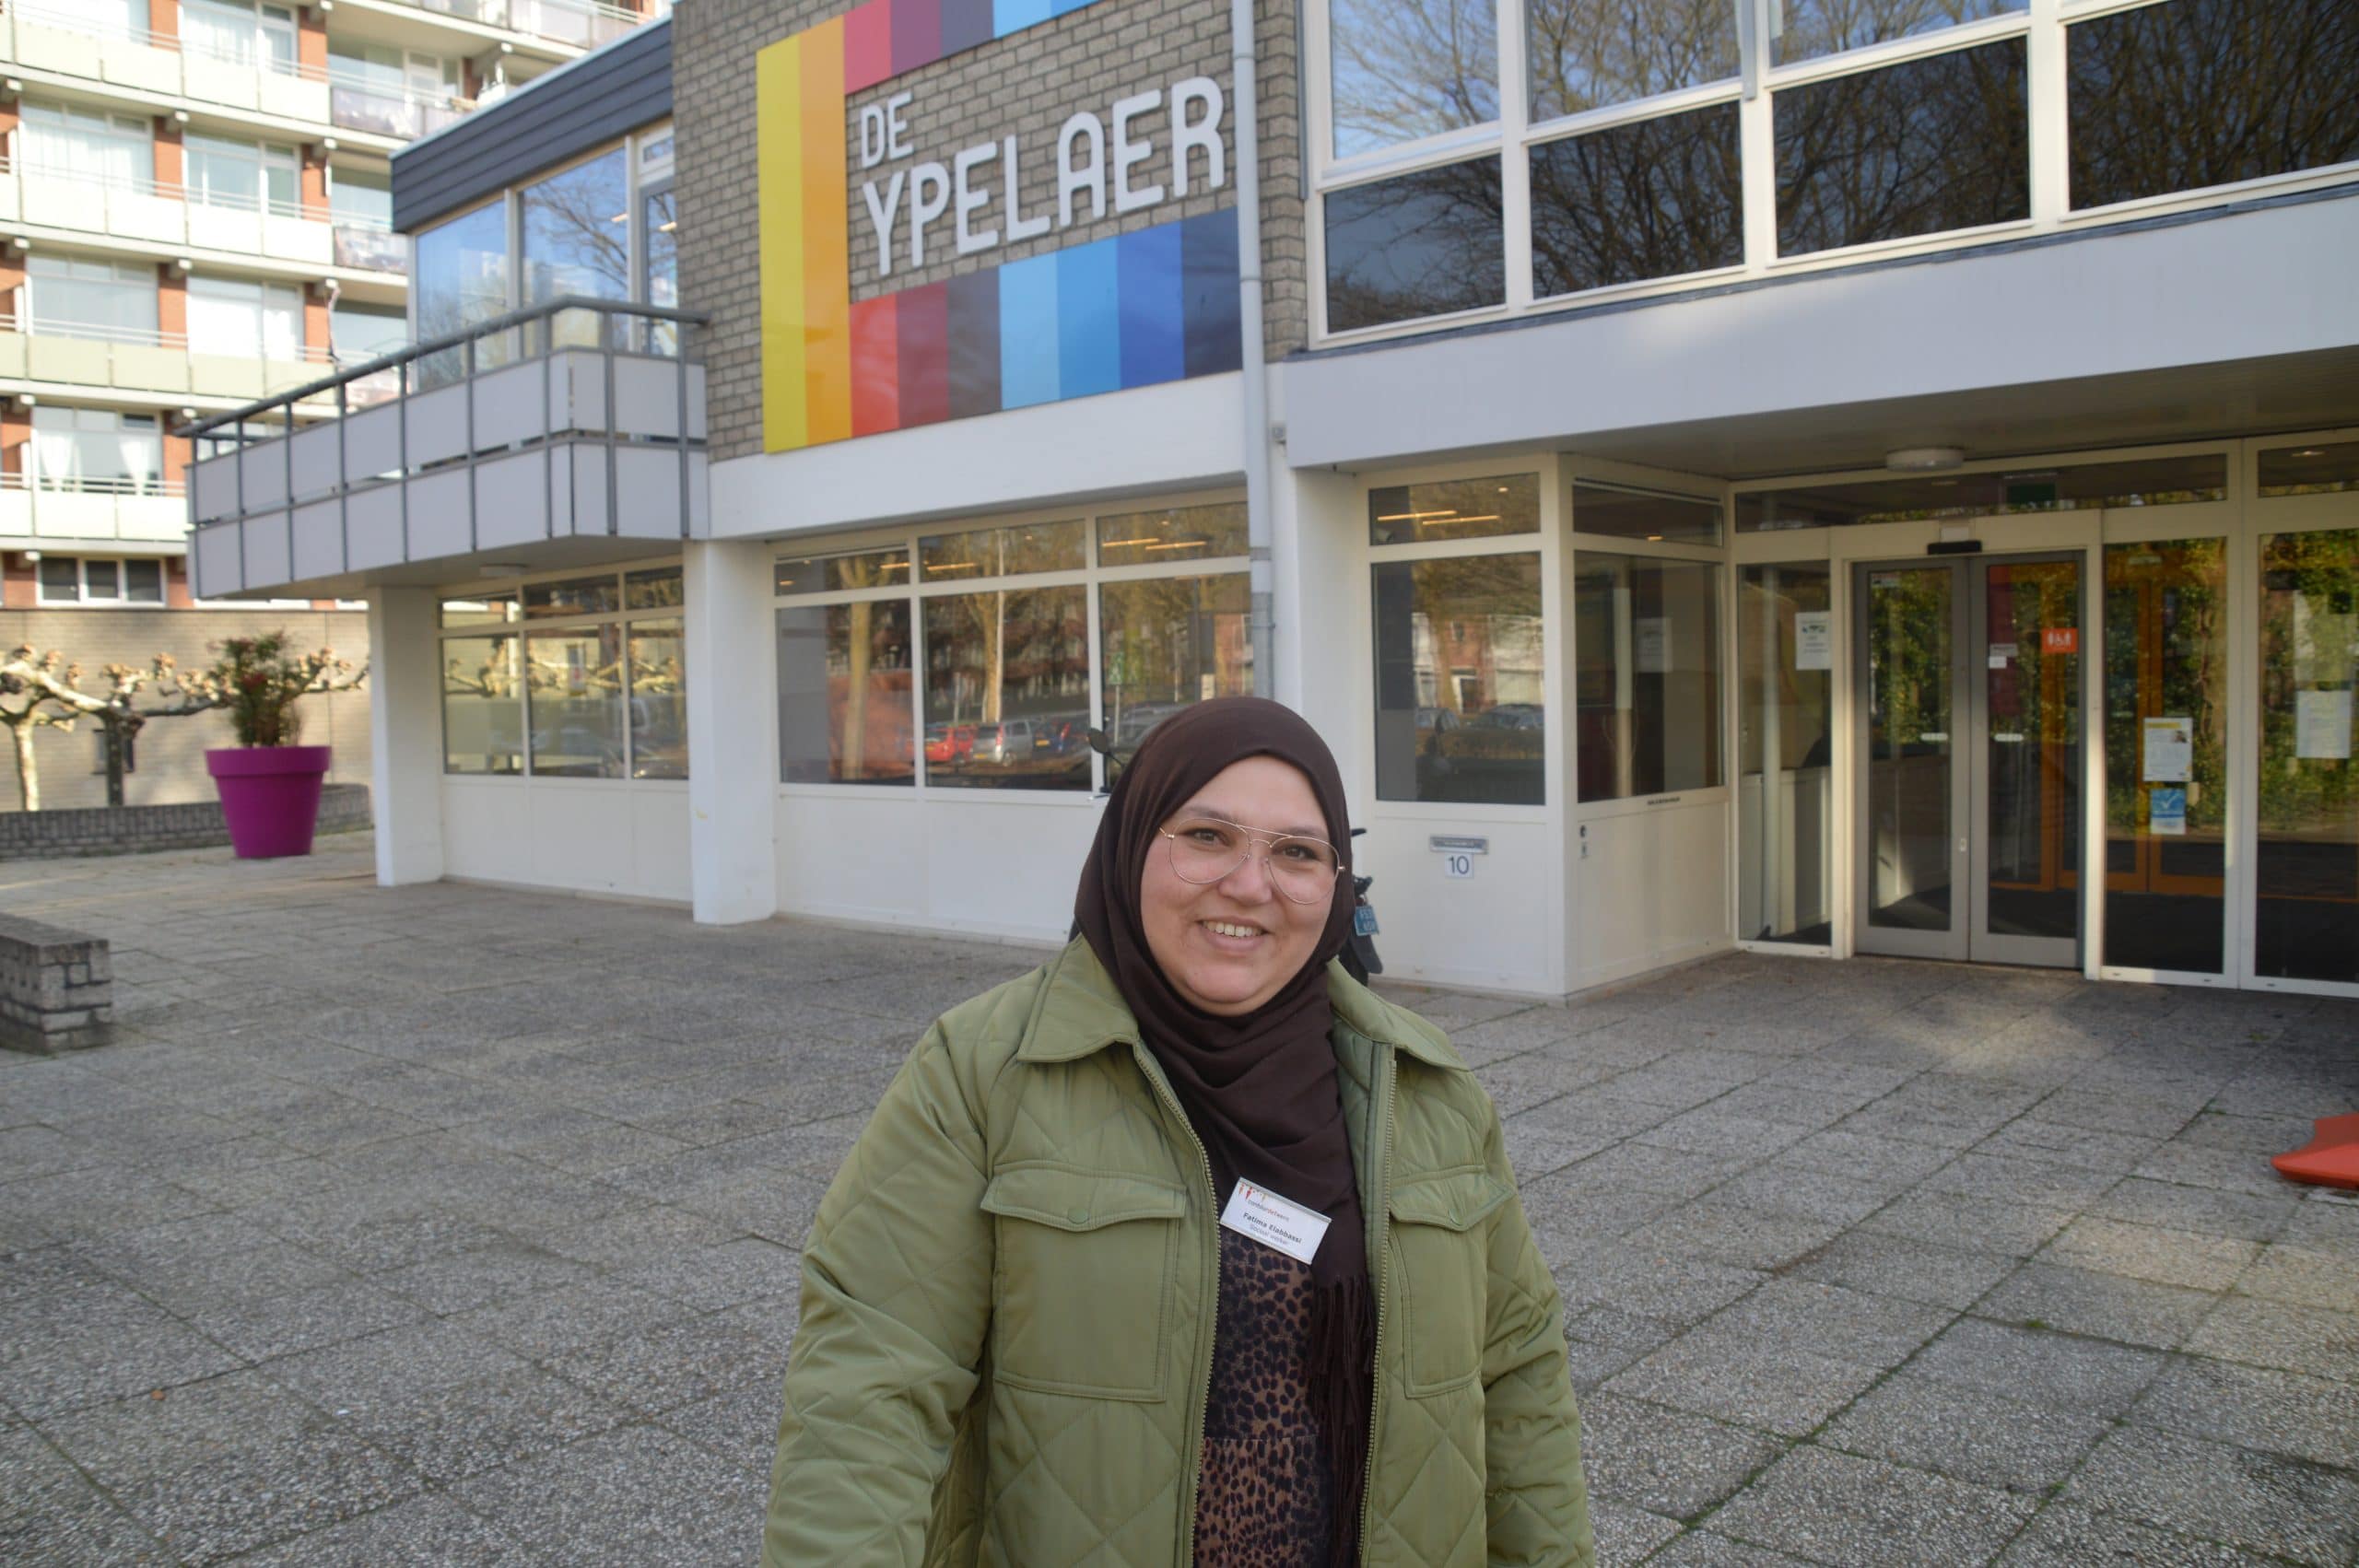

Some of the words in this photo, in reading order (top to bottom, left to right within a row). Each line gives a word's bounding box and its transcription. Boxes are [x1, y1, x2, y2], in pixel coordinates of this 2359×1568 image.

[860, 91, 914, 170] DE
[863, 76, 1225, 276] YPELAER
[1448, 855, 1470, 875] 10
[1243, 1212, 1267, 1228] Fatima
